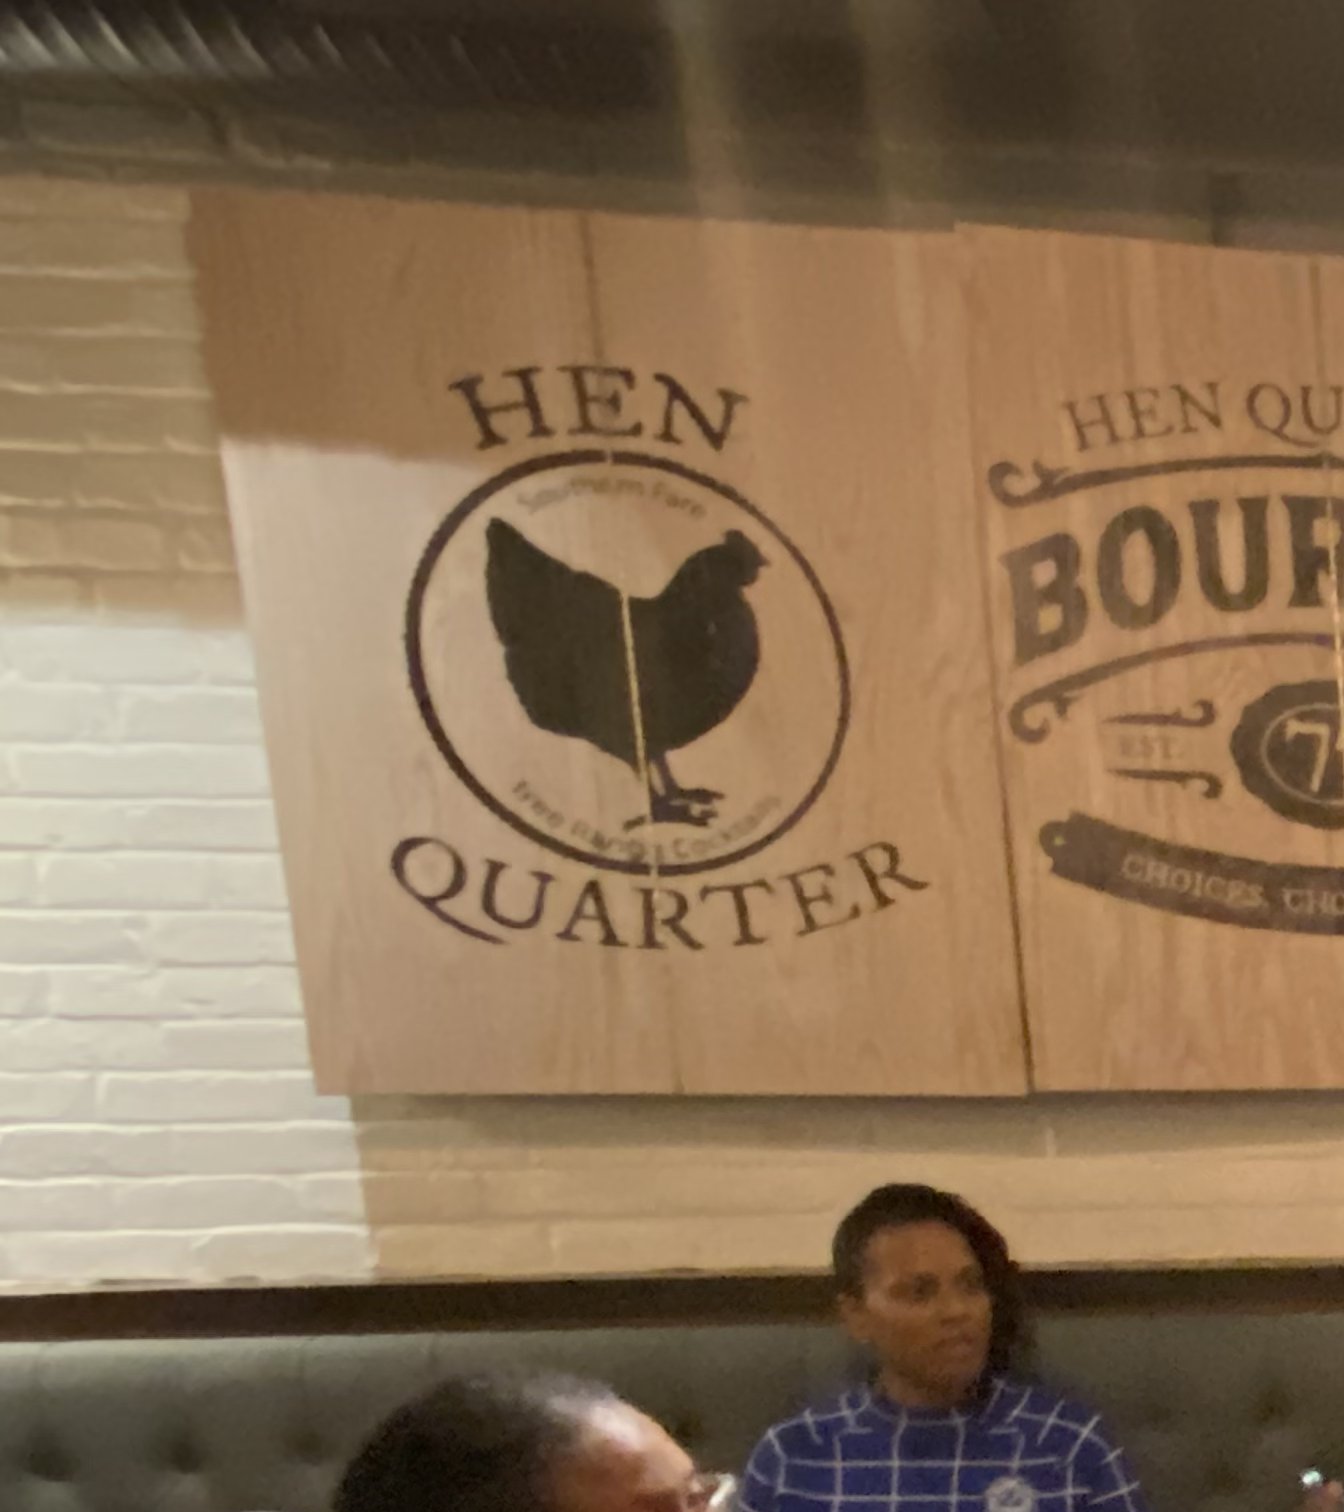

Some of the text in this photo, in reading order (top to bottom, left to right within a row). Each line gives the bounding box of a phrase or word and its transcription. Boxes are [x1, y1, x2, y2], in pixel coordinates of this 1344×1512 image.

[449, 365, 750, 451] HEN
[1060, 380, 1224, 452] HEN
[390, 836, 930, 950] QUARTER
